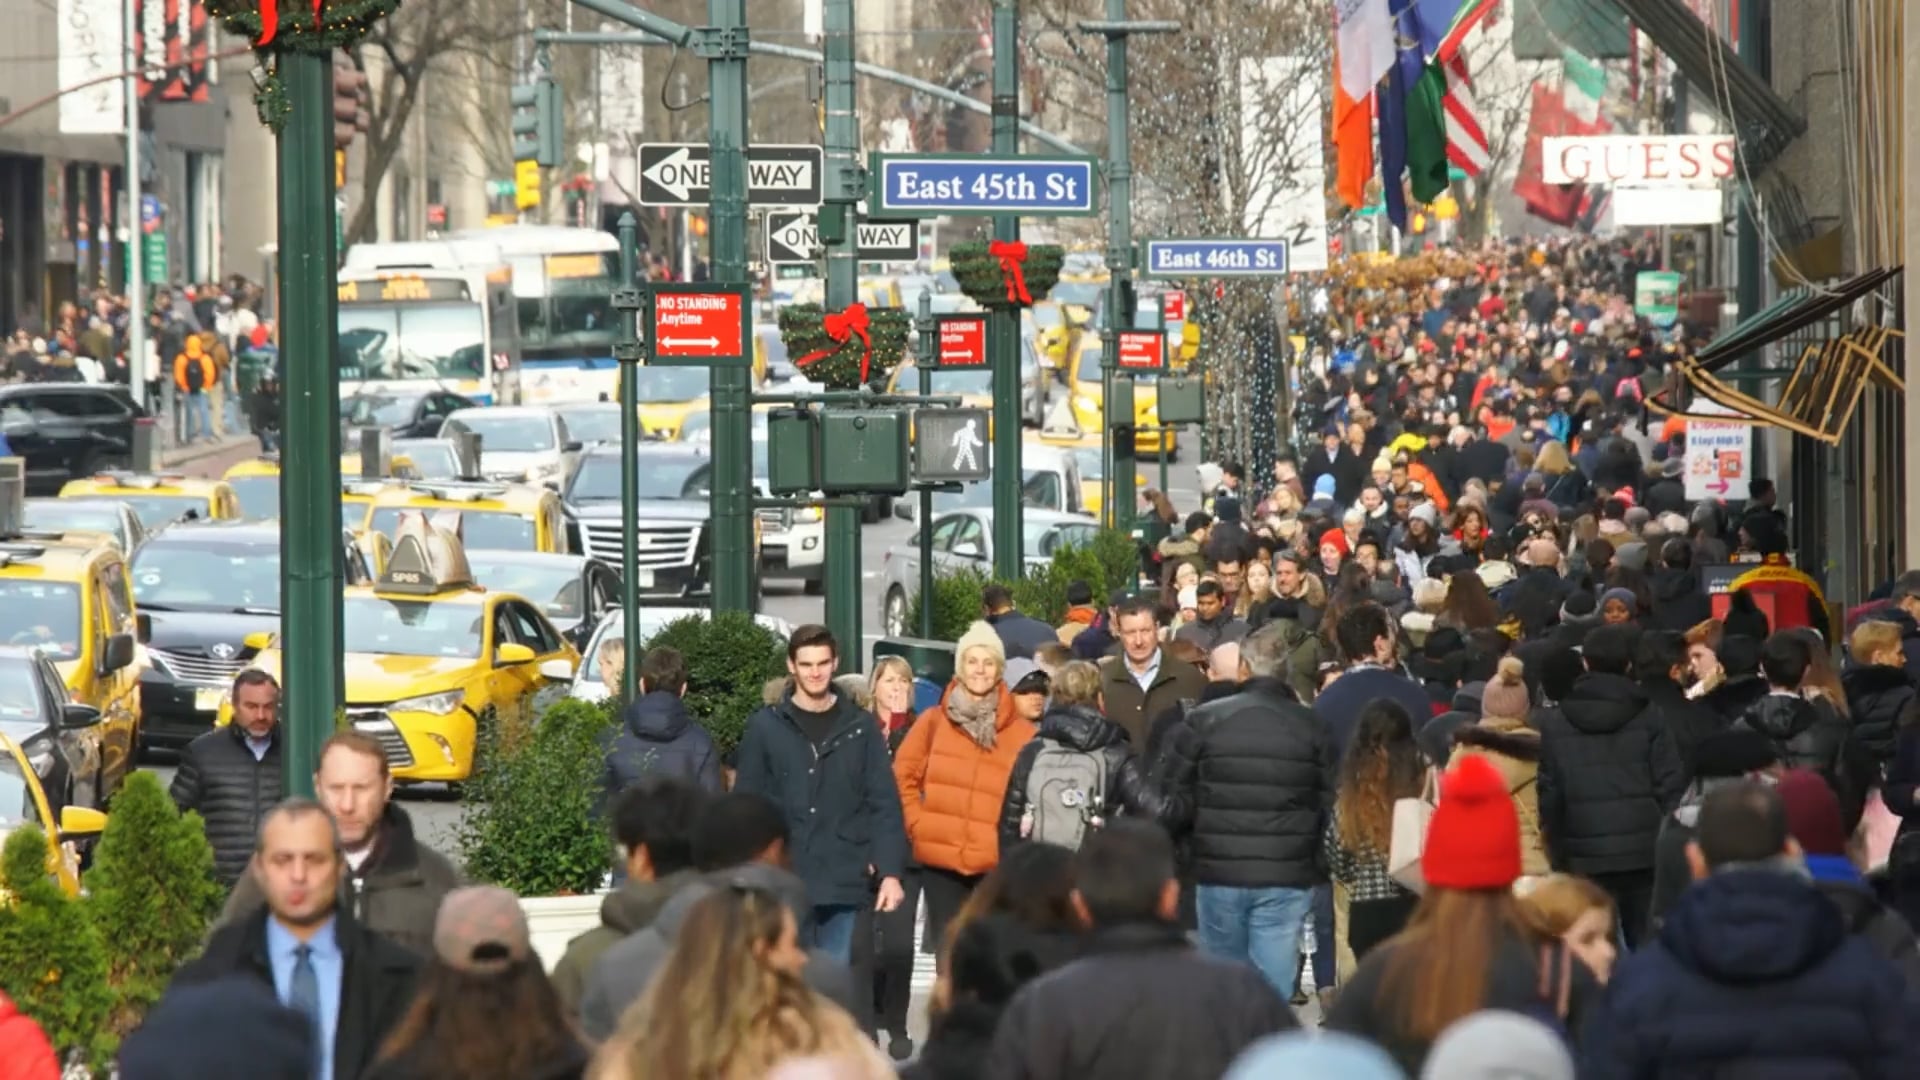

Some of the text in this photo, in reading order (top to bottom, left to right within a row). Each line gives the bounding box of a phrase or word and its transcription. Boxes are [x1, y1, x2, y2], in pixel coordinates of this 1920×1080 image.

[1560, 141, 1735, 180] GUESS
[750, 164, 804, 187] WAY
[897, 171, 1077, 200] East 45th St
[785, 227, 904, 246] ON WAY
[1158, 248, 1277, 268] East 46th St
[660, 297, 727, 310] NO STANDING
[661, 312, 703, 327] Anytime
